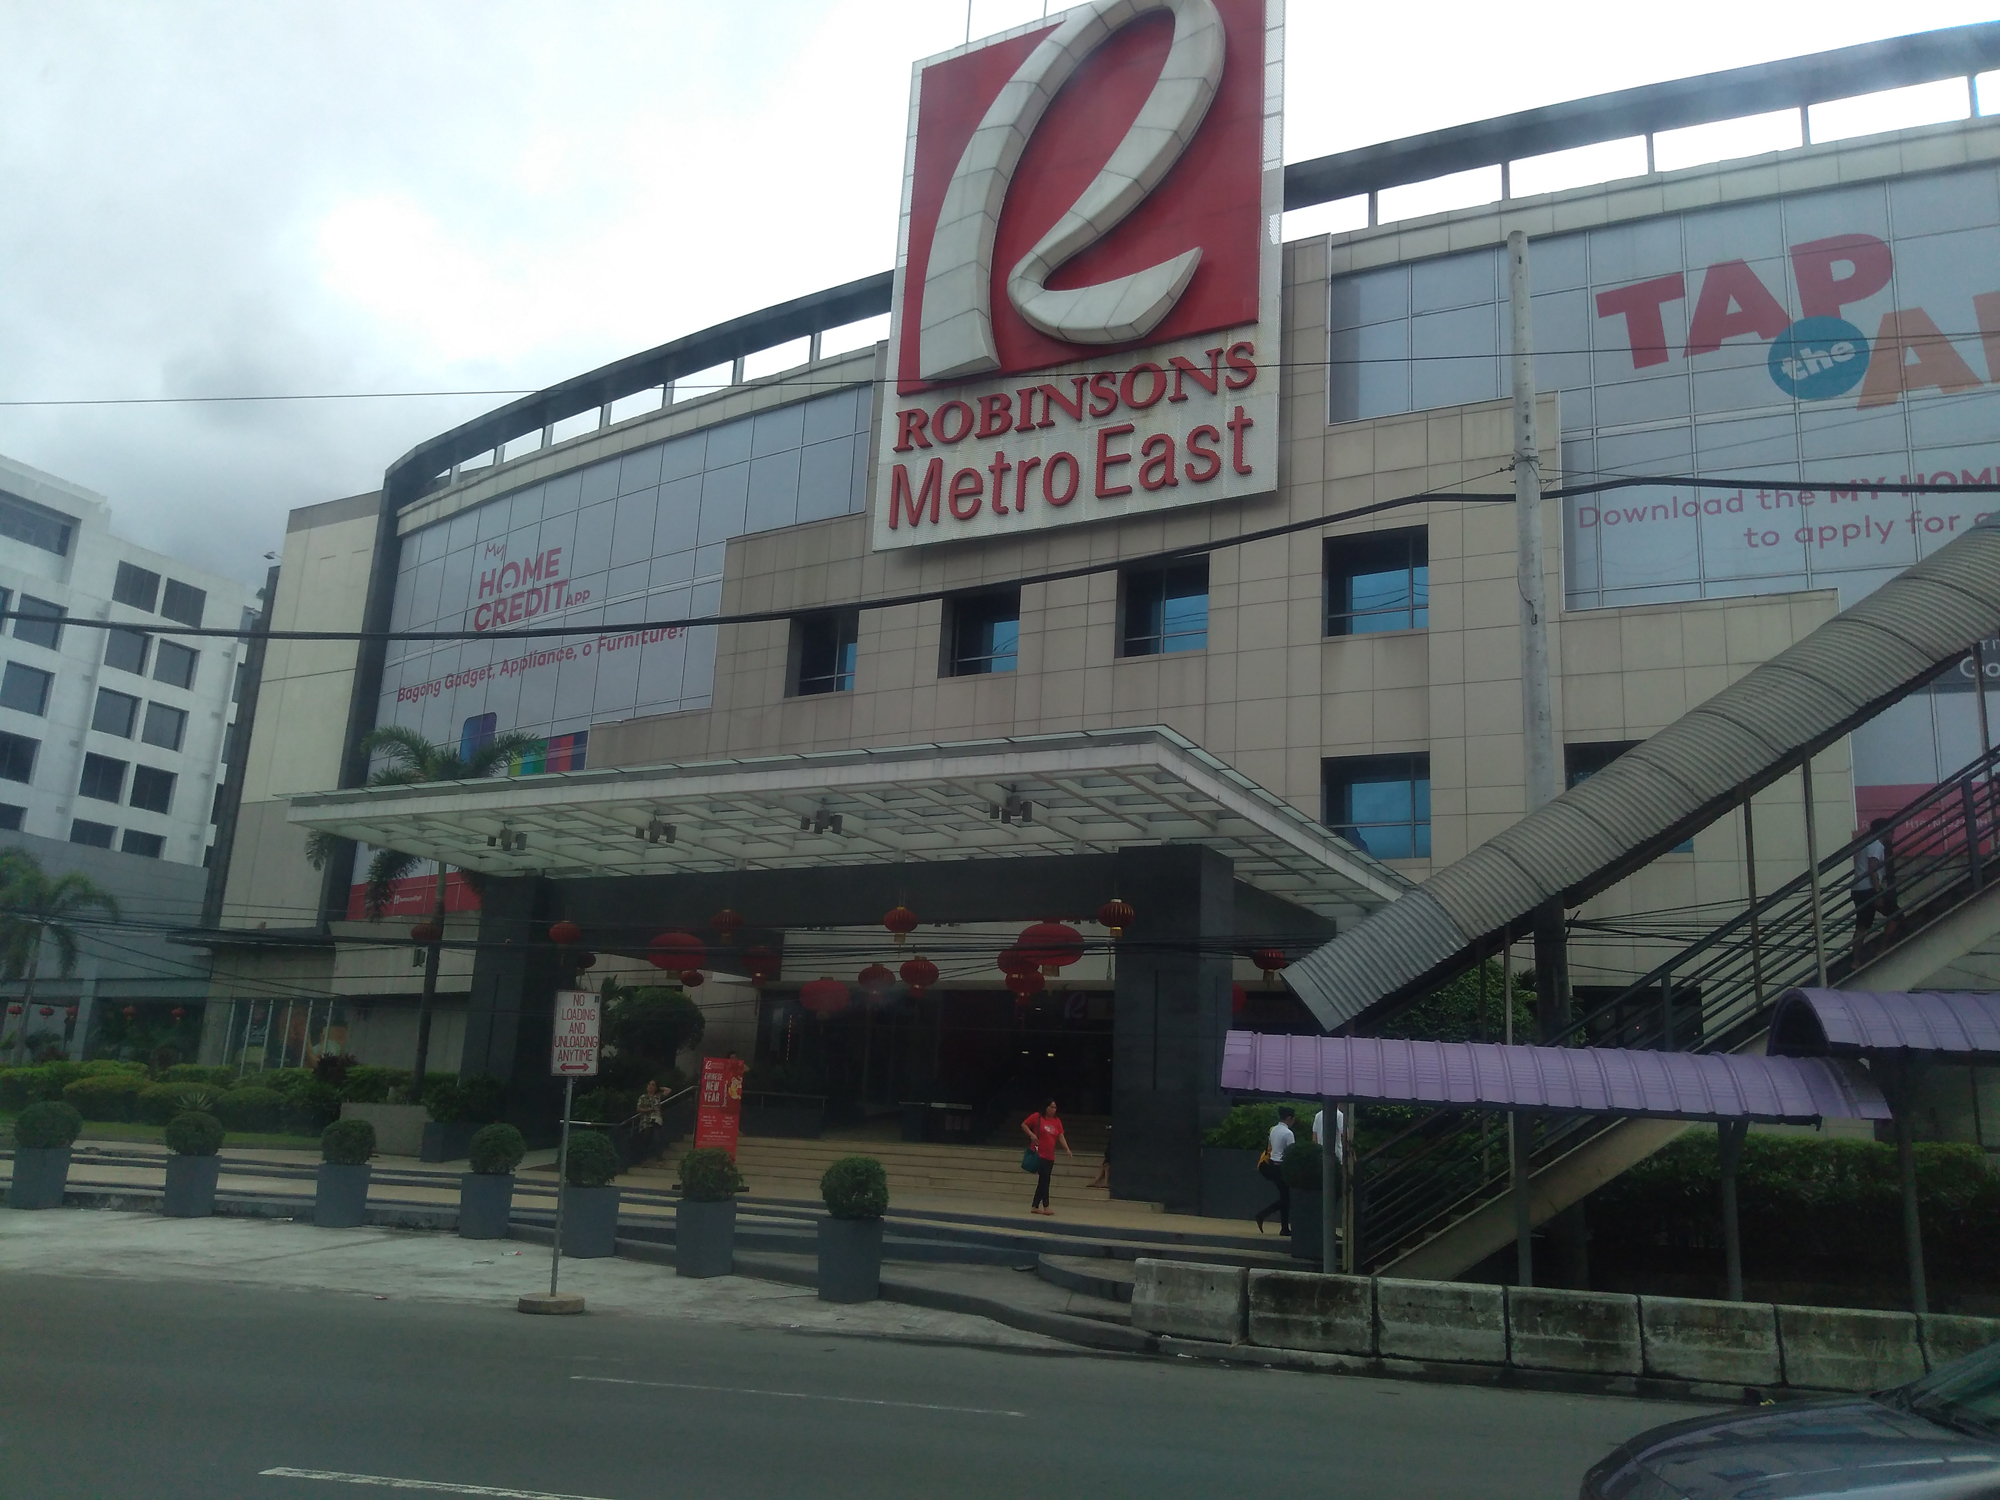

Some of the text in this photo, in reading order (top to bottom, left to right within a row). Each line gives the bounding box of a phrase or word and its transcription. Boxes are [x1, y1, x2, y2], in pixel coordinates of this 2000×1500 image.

[1595, 233, 1893, 370] TAP
[1780, 339, 1857, 382] the
[1857, 290, 2000, 411] A
[892, 341, 1258, 453] ROBINSONS
[1579, 466, 2000, 528] Download the MY HOM
[1743, 527, 1780, 548] to
[1794, 515, 1894, 550] apply
[1905, 510, 1961, 535] for
[484, 541, 506, 562] My
[478, 547, 562, 600] HOME
[474, 578, 591, 632] CREDIT APP
[397, 625, 687, 703] Bagong Gadget, Appliance, o Furniture?
[561, 1008, 596, 1021] LOADING
[572, 994, 585, 1006] NO
[554, 1035, 598, 1048] UNLOADING
[568, 1022, 586, 1034] AND
[557, 1049, 593, 1062] ANYTIME
[704, 1072, 723, 1081] CHINESE
[705, 1081, 720, 1091] NEW
[704, 1092, 720, 1103] YEAR
